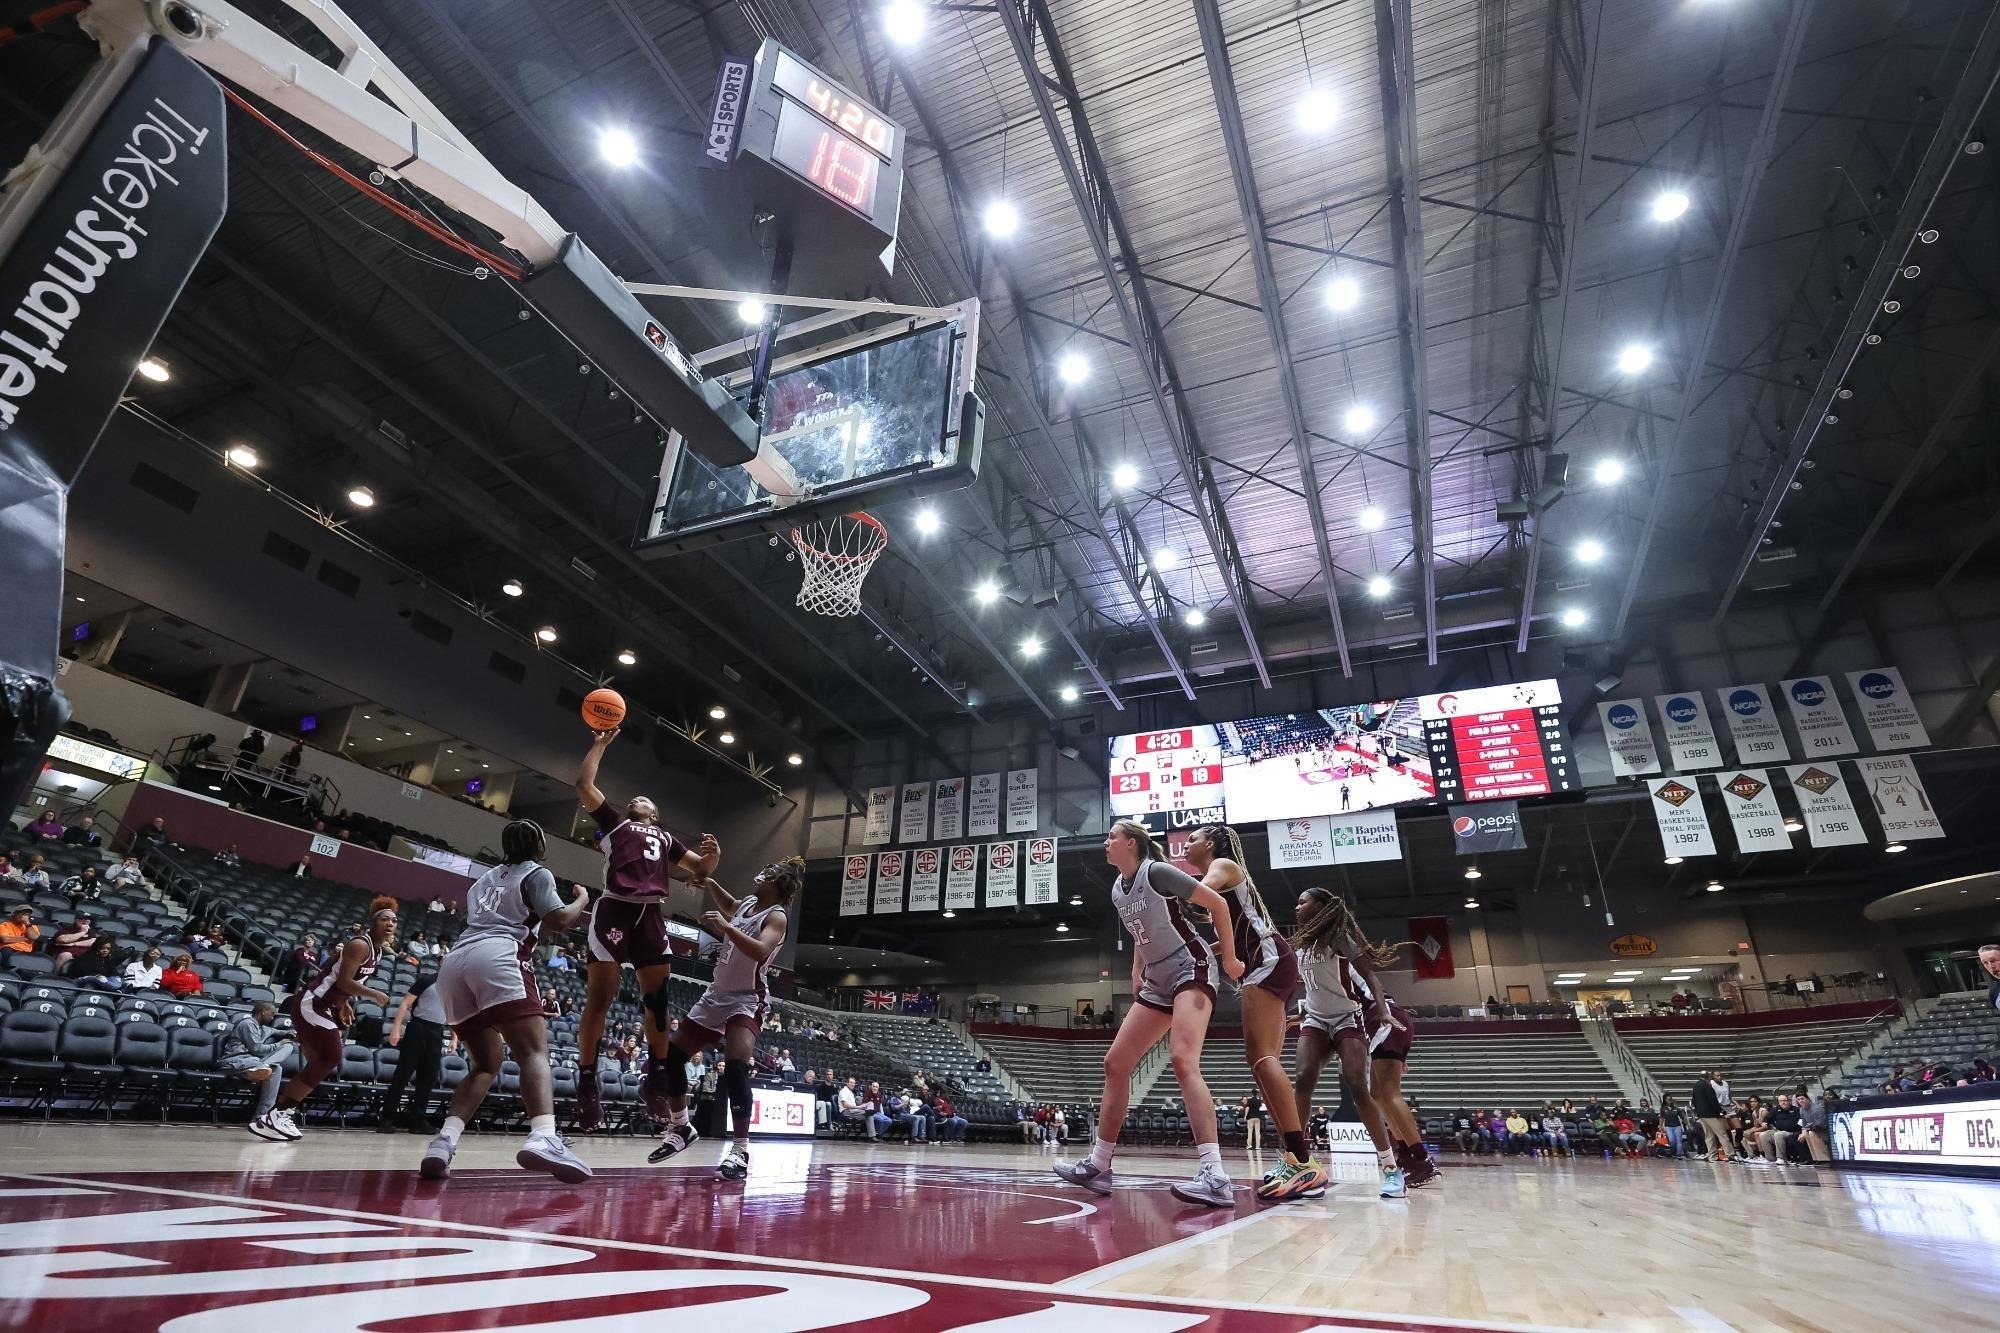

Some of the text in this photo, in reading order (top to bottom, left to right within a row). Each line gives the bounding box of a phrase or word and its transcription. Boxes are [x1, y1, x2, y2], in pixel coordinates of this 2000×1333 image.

[707, 64, 744, 163] ACE SPORTS
[809, 79, 887, 149] 4:20
[811, 132, 871, 205] 18
[1865, 684, 1895, 694] NCAA
[1797, 691, 1826, 700] NCAA
[1734, 701, 1761, 710] NCAA
[1670, 708, 1697, 718] NCAA
[1612, 715, 1638, 724] NCAA
[1146, 732, 1181, 750] 4:20
[1814, 736, 1841, 747] 2011
[1748, 741, 1775, 752] 1990
[1683, 749, 1708, 759] 1989
[1622, 755, 1647, 765] 1986
[1865, 760, 1908, 771] FISHER
[1437, 768, 1452, 776] 3/7
[1120, 776, 1141, 791] 29
[1804, 777, 1830, 785] NIT
[1734, 783, 1757, 792] NIT
[1664, 790, 1687, 798] NIT
[1896, 795, 1906, 806] 4
[1802, 803, 1852, 814] BASKETBALL
[1731, 810, 1778, 820] BASKETBALL
[971, 819, 996, 827] 2015-16
[1477, 813, 1517, 829] pepsi
[1660, 816, 1705, 825] BASKETBALL
[1883, 819, 1939, 831] 1992-1996
[629, 825, 658, 835] TEXAS
[1355, 823, 1395, 835] Baptist
[1820, 822, 1849, 833] 1996
[1674, 833, 1699, 843] 1987
[1747, 828, 1775, 838] 1988
[1357, 833, 1395, 845] Health
[317, 843, 334, 855] 102
[643, 836, 661, 861] 3
[1279, 841, 1323, 850] ARKANSAS
[1283, 848, 1321, 857] FEDERAL
[1330, 1129, 1372, 1141] UAMS
[1863, 1119, 1892, 1150] NEXT
